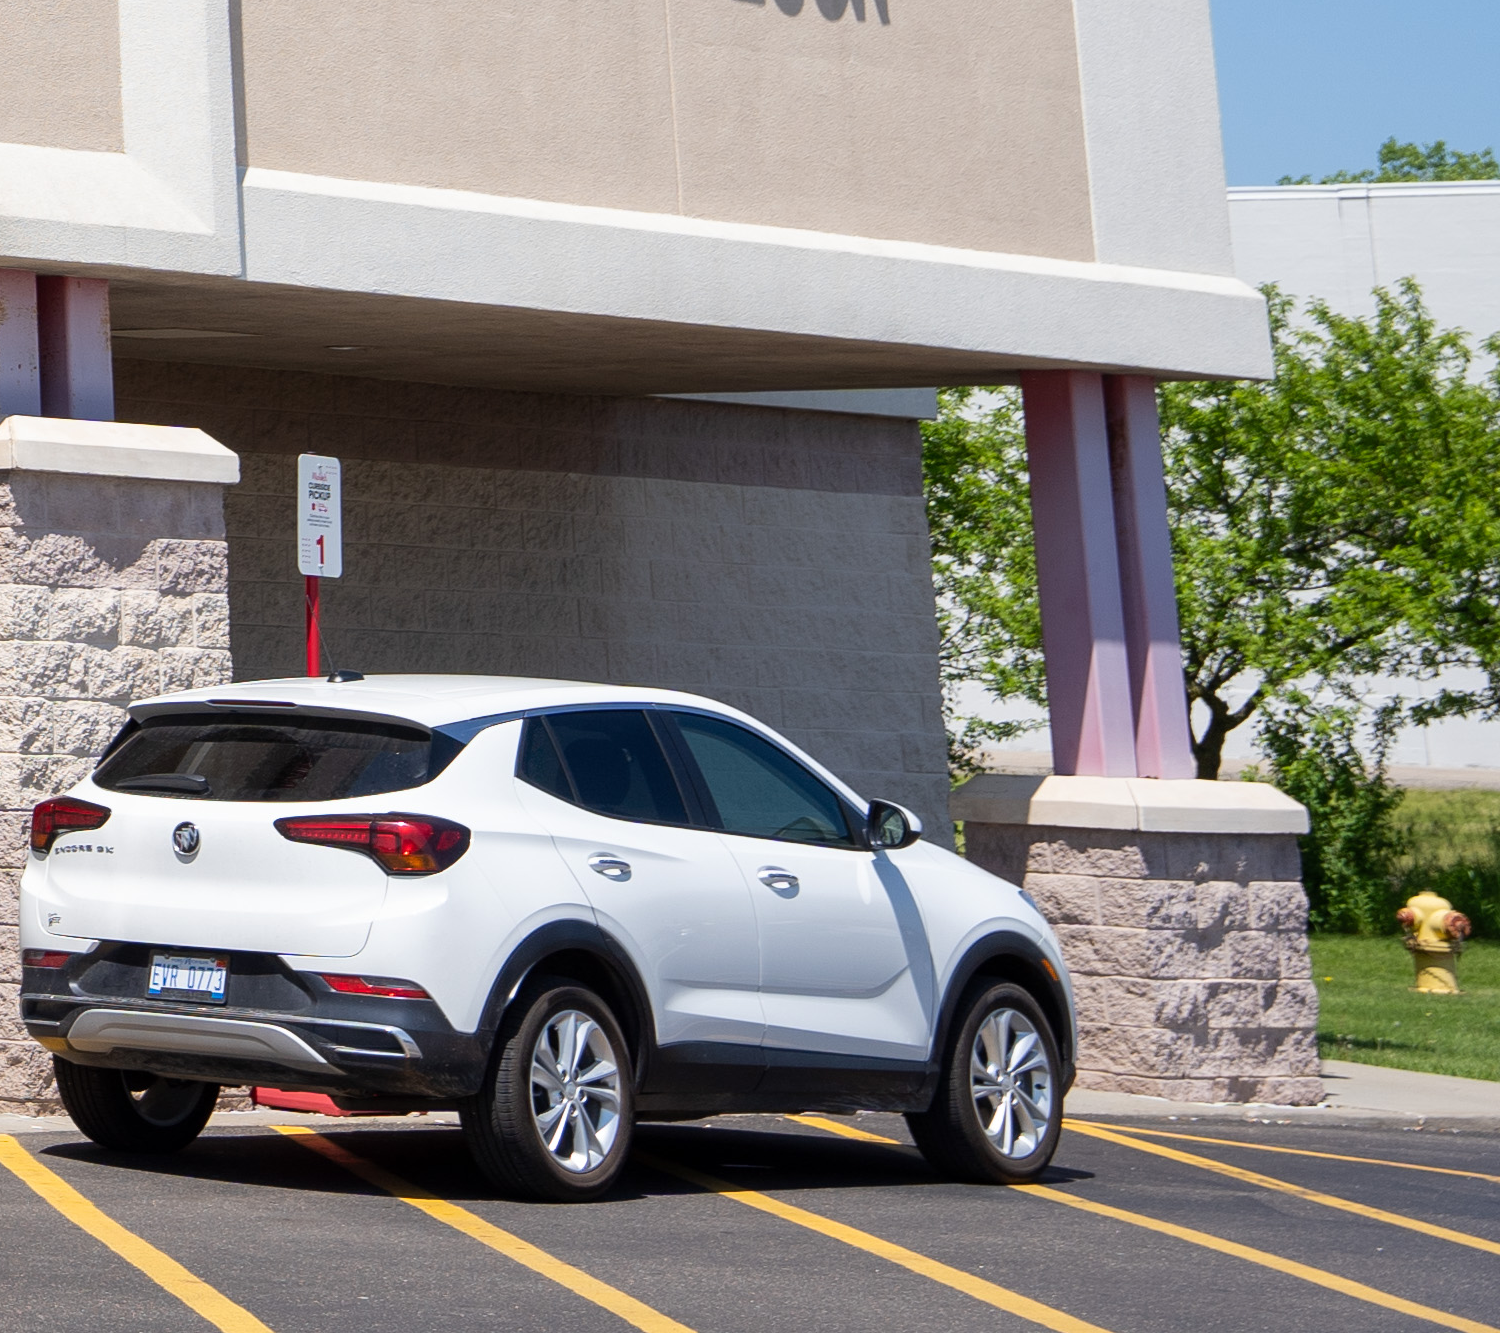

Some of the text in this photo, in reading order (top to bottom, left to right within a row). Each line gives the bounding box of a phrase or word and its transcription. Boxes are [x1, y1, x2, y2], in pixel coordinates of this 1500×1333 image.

[308, 490, 331, 501] PICKUP
[316, 534, 324, 565] 1
[152, 963, 224, 991] EVR 0773
